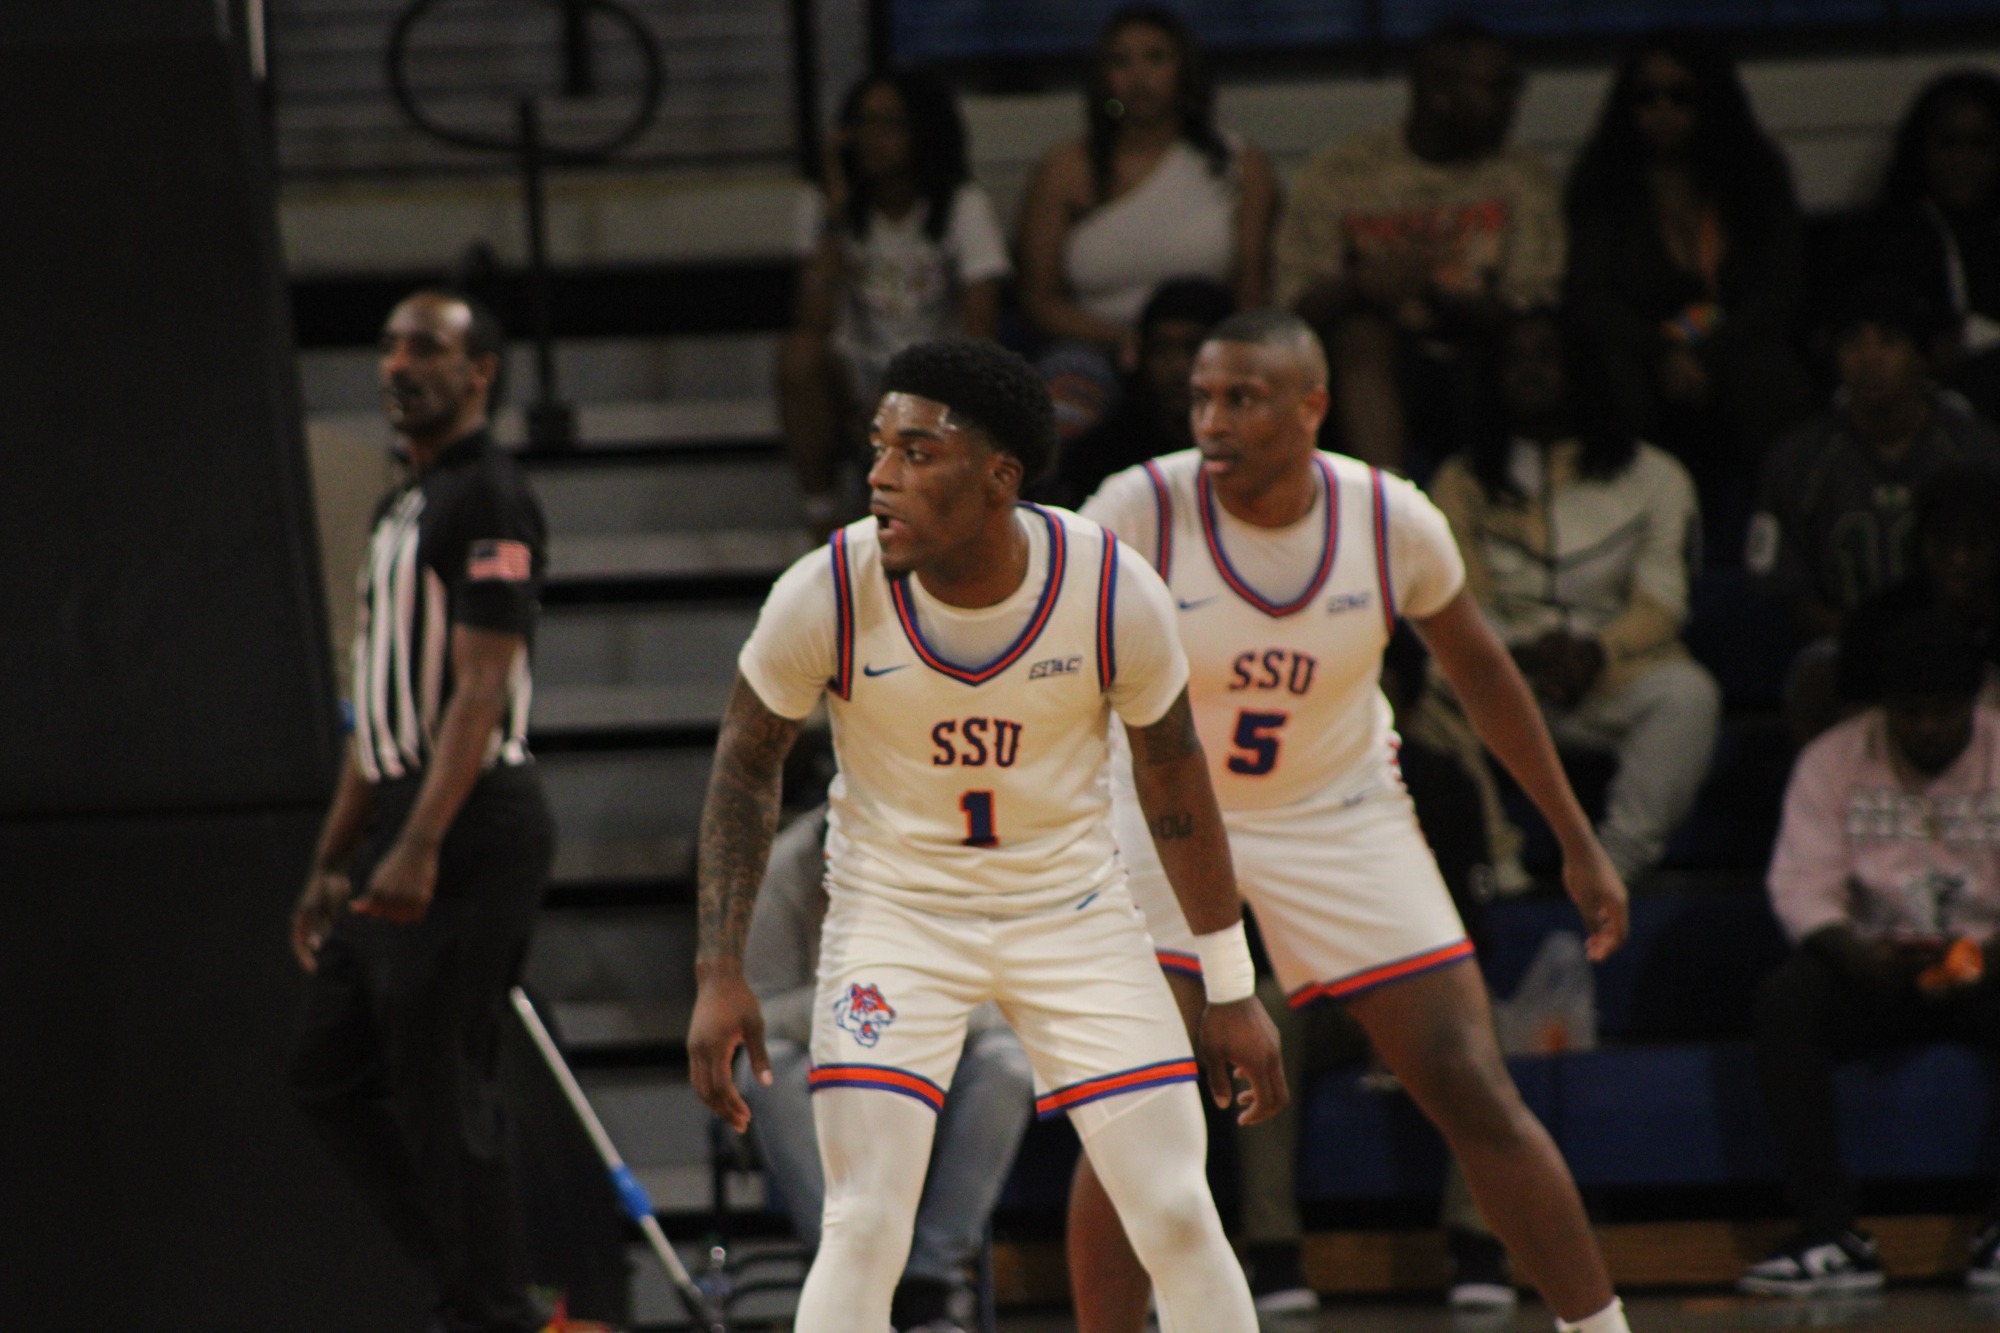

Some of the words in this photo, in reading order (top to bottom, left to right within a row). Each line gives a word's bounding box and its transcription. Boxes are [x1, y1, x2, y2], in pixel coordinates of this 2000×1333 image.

[1229, 648, 1317, 695] SSU
[931, 716, 1023, 768] SSU
[1225, 707, 1291, 777] 5
[959, 789, 999, 848] 1
